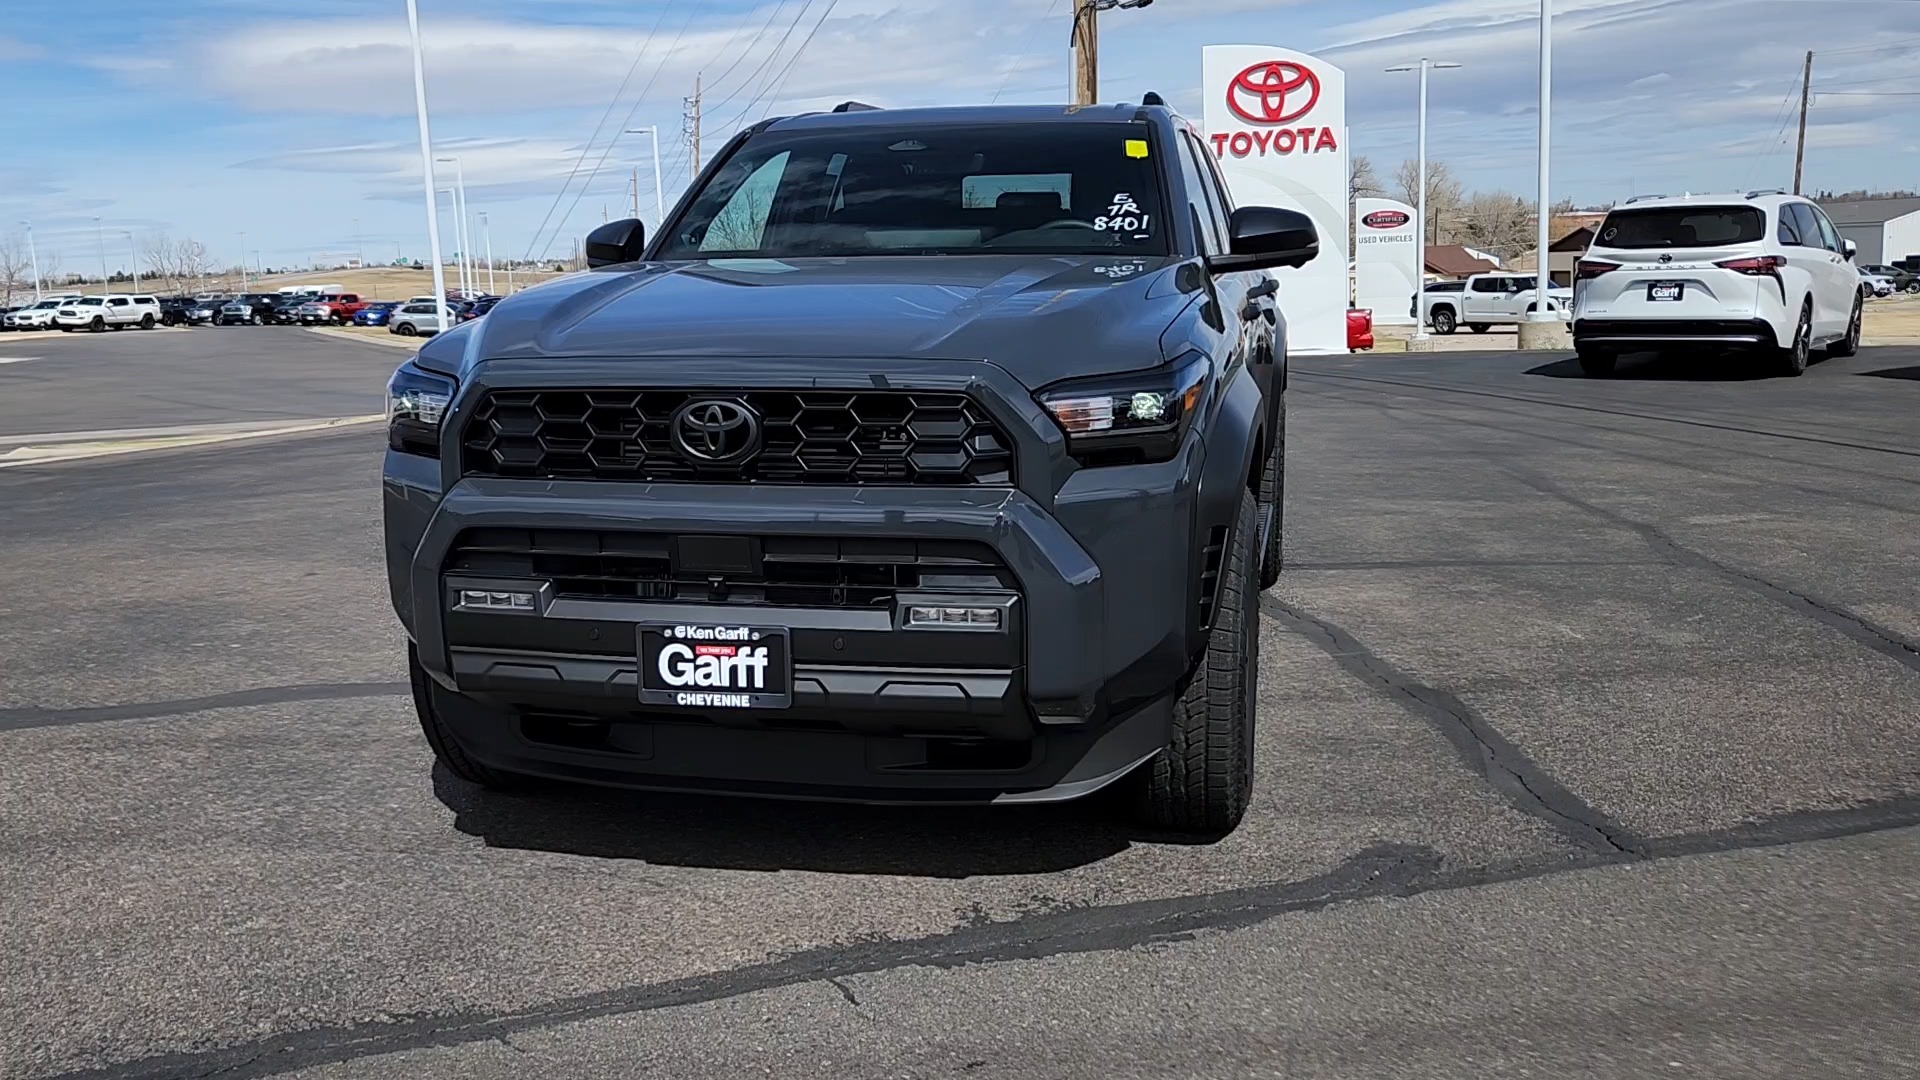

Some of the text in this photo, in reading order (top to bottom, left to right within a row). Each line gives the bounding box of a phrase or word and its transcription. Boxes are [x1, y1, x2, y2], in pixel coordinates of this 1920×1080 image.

[1211, 127, 1337, 159] TOYOTA
[1093, 215, 1149, 231] 8401
[1359, 235, 1413, 244] USED VEHICLES
[1652, 286, 1679, 297] Garff
[687, 626, 714, 640] Ken
[715, 627, 749, 640] Garff
[658, 643, 769, 689] Garff
[677, 693, 750, 707] CHEYENNE
